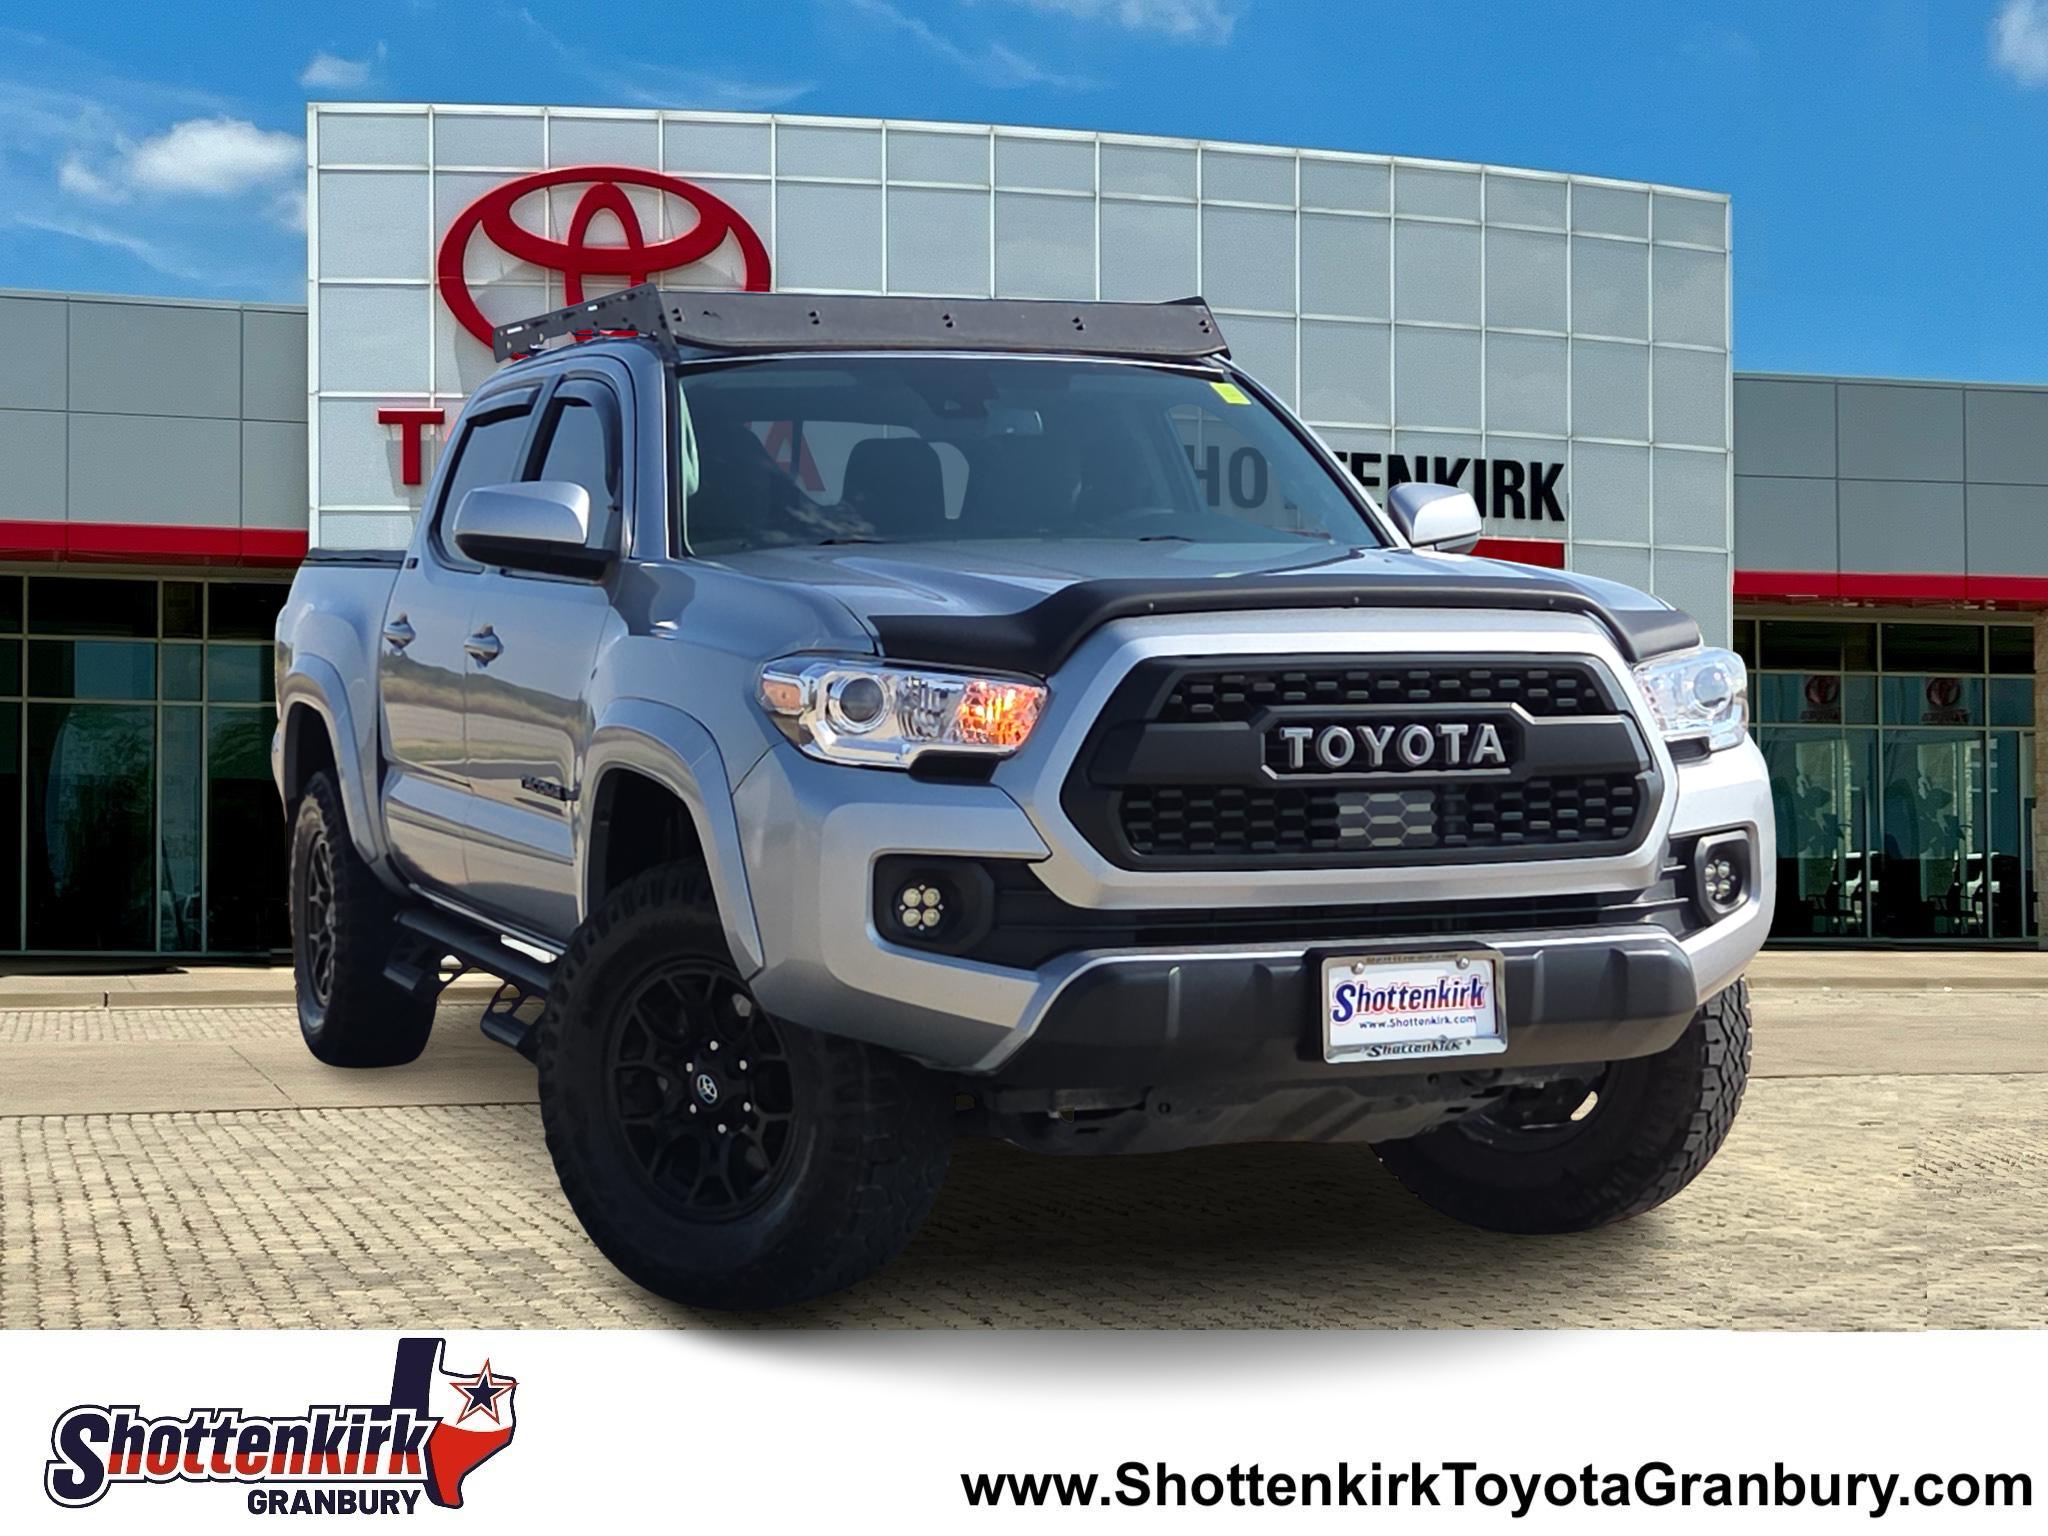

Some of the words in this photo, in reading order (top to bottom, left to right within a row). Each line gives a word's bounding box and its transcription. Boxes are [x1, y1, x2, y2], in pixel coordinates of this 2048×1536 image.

[1280, 723, 1506, 769] TOYOTA
[1331, 976, 1486, 1023] Shottenkirk
[1359, 1014, 1477, 1029] www.Shottenkirk.com
